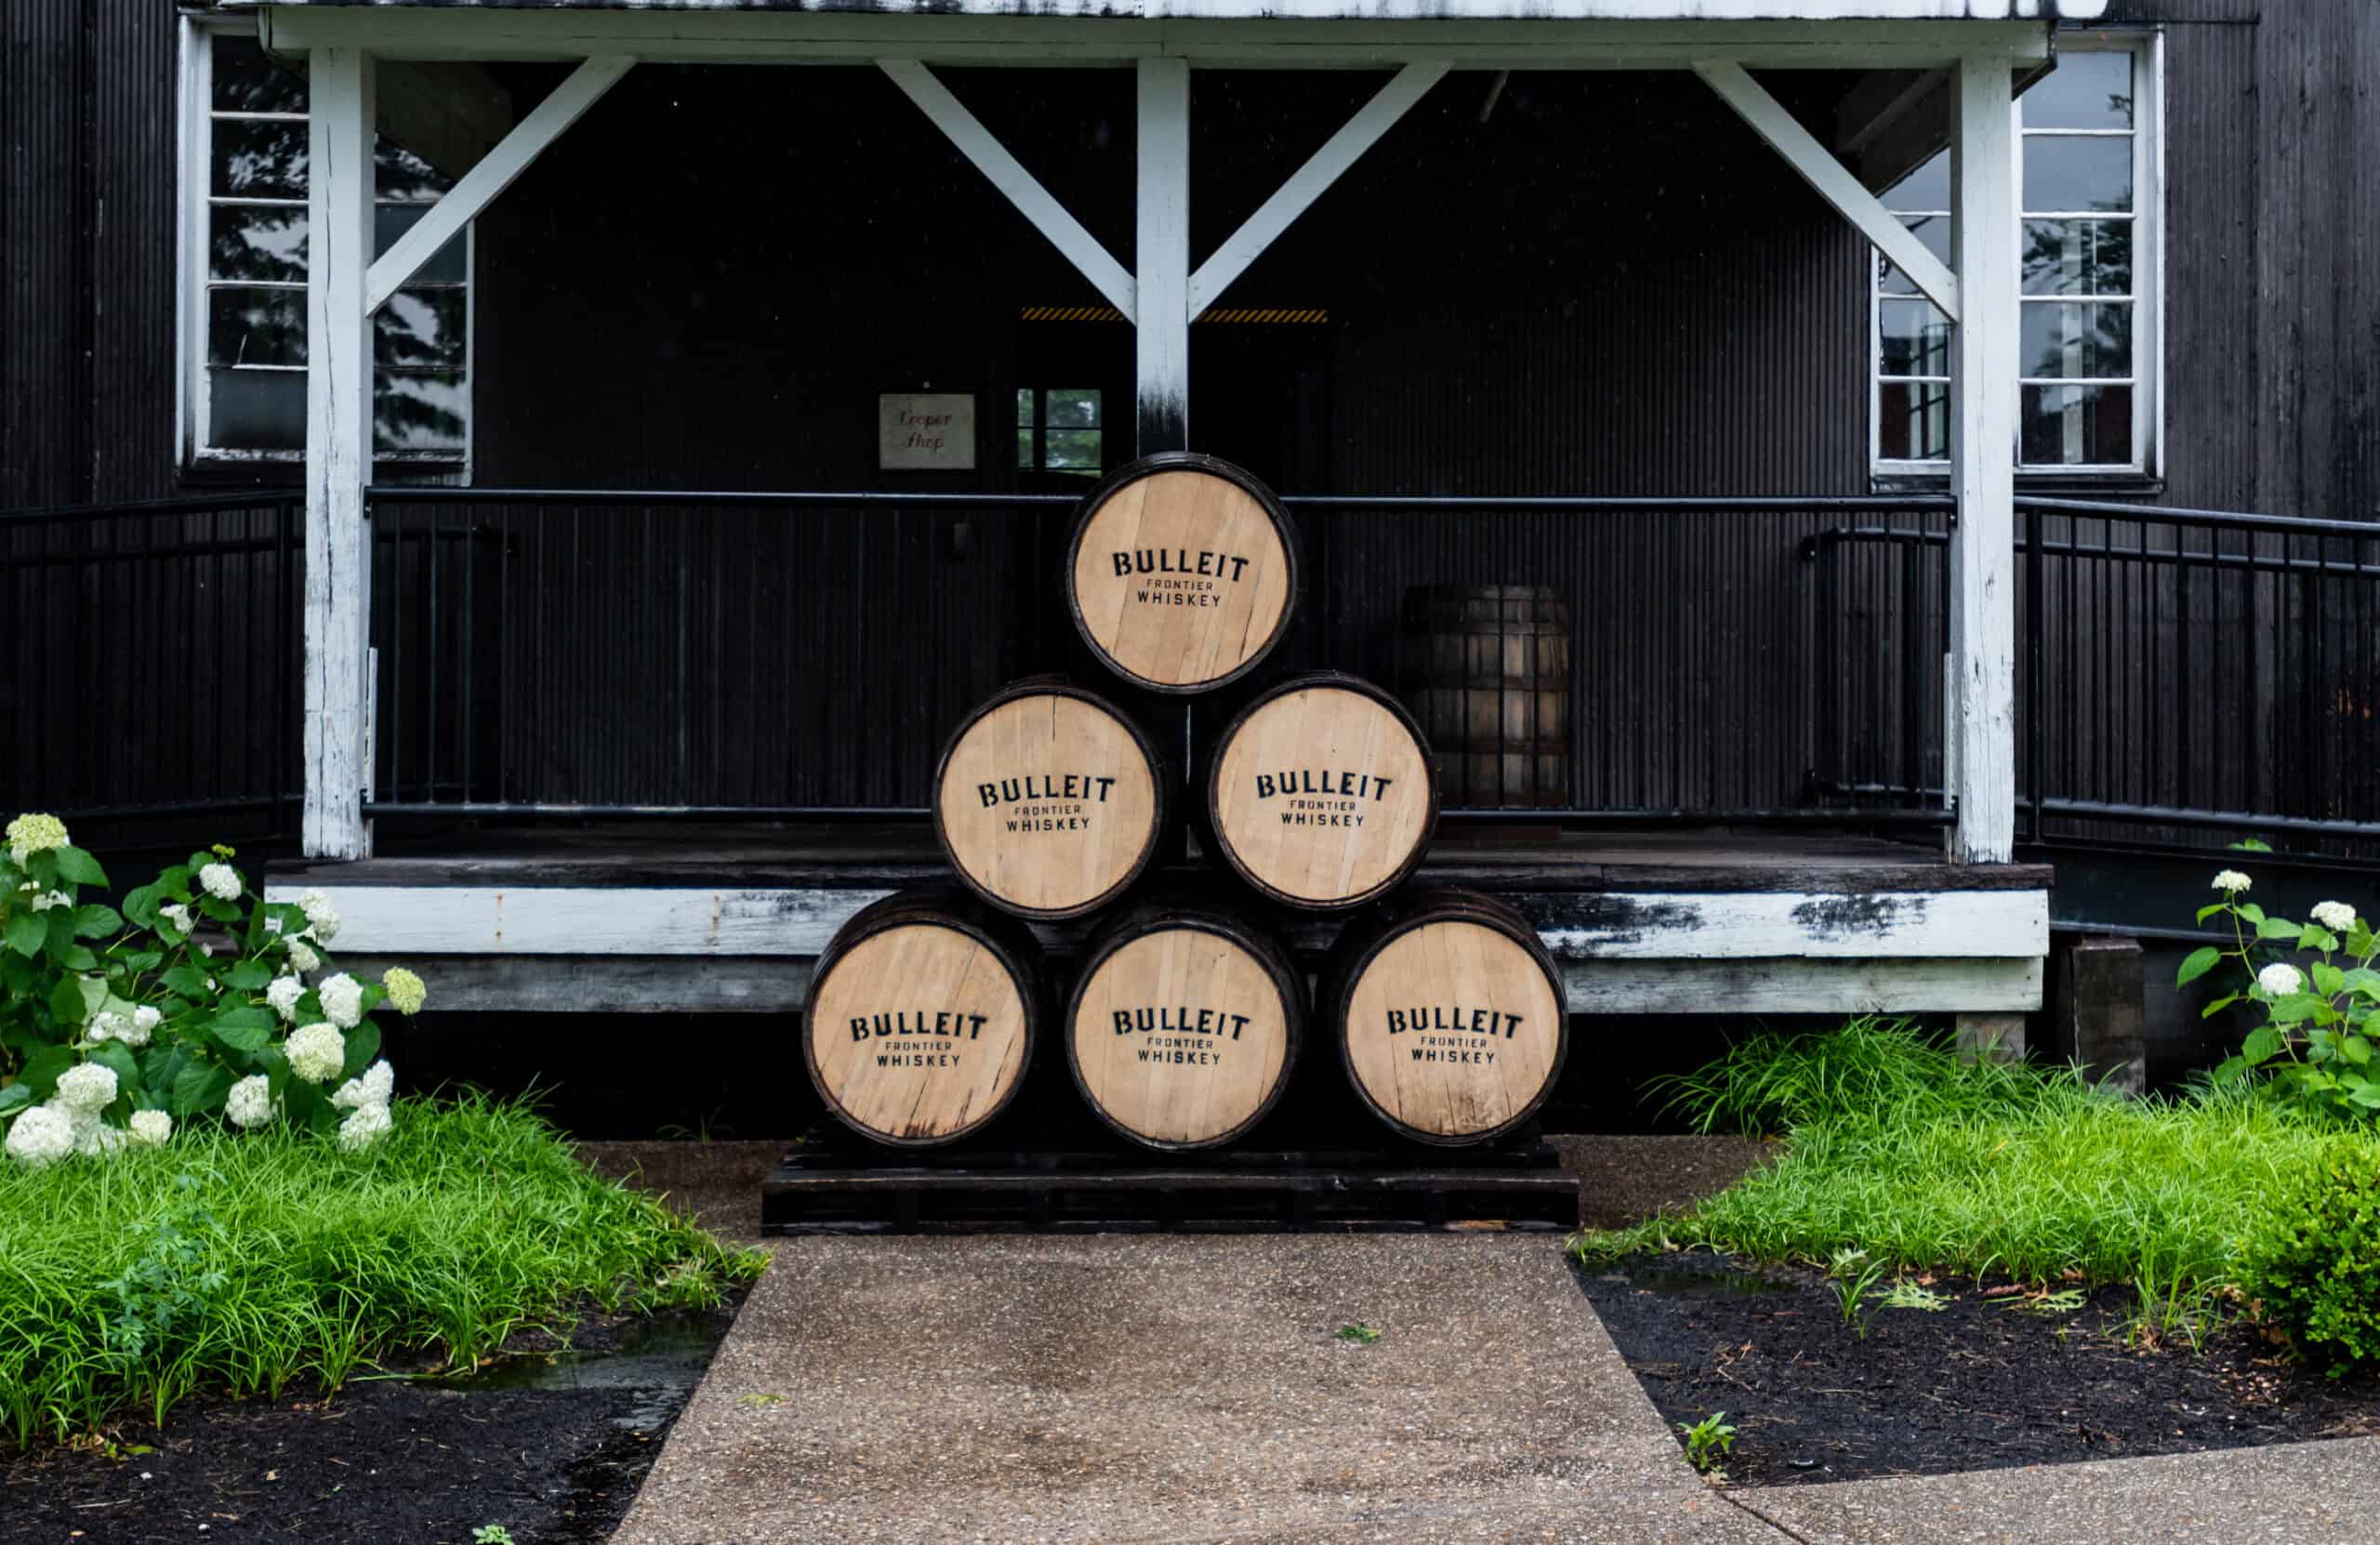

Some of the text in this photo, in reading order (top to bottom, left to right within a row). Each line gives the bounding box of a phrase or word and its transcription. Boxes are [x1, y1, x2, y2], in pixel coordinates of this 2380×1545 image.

[900, 409, 953, 429] Cooper
[903, 431, 945, 454] Shop
[1112, 549, 1250, 582] BULLEIT
[1146, 578, 1213, 591] FRONTIER
[1137, 591, 1222, 607] WHISKEY
[978, 774, 1117, 808] BULLEIT
[1256, 770, 1393, 801] BULLEIT
[1014, 804, 1081, 816] FRONTIER
[1289, 799, 1356, 812] FRONTIER
[1006, 817, 1091, 832] WHISKEY
[1281, 812, 1365, 826] WHISKEY
[850, 1010, 988, 1042] BULLEIT
[1113, 1007, 1250, 1041] BULLEIT
[1387, 1007, 1524, 1039] BULLEIT
[885, 1041, 952, 1051] FRONTIER
[1147, 1037, 1213, 1050] FRONTIER
[1421, 1036, 1488, 1049] FRONTIER
[877, 1055, 961, 1067] WHISKEY
[1138, 1050, 1221, 1065] WHISKEY
[1411, 1049, 1496, 1064] WHISKEY
